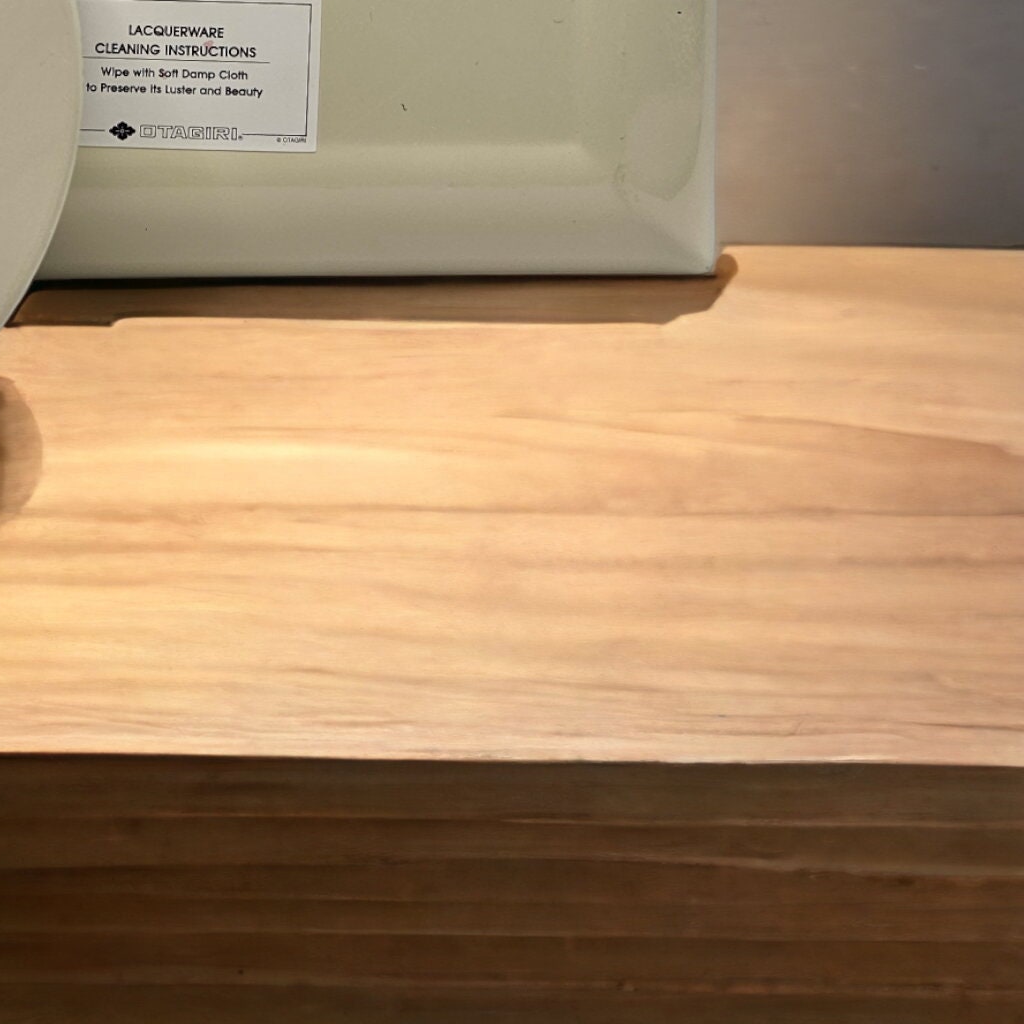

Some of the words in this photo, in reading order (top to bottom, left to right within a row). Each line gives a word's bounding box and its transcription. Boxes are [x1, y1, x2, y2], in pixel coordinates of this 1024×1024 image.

[128, 24, 224, 39] LACQUERWARE
[94, 42, 160, 56] CLEANING
[164, 44, 257, 58] INSTRUCTIONS
[101, 66, 130, 78] Wipe
[133, 67, 155, 77] with
[158, 68, 178, 78] Soft
[182, 69, 216, 81] Damp
[219, 70, 248, 80] Cloth
[86, 82, 97, 92] to
[100, 82, 147, 93] Preserve
[165, 84, 196, 95] Luster
[199, 86, 222, 96] and
[225, 86, 264, 99] Beauty
